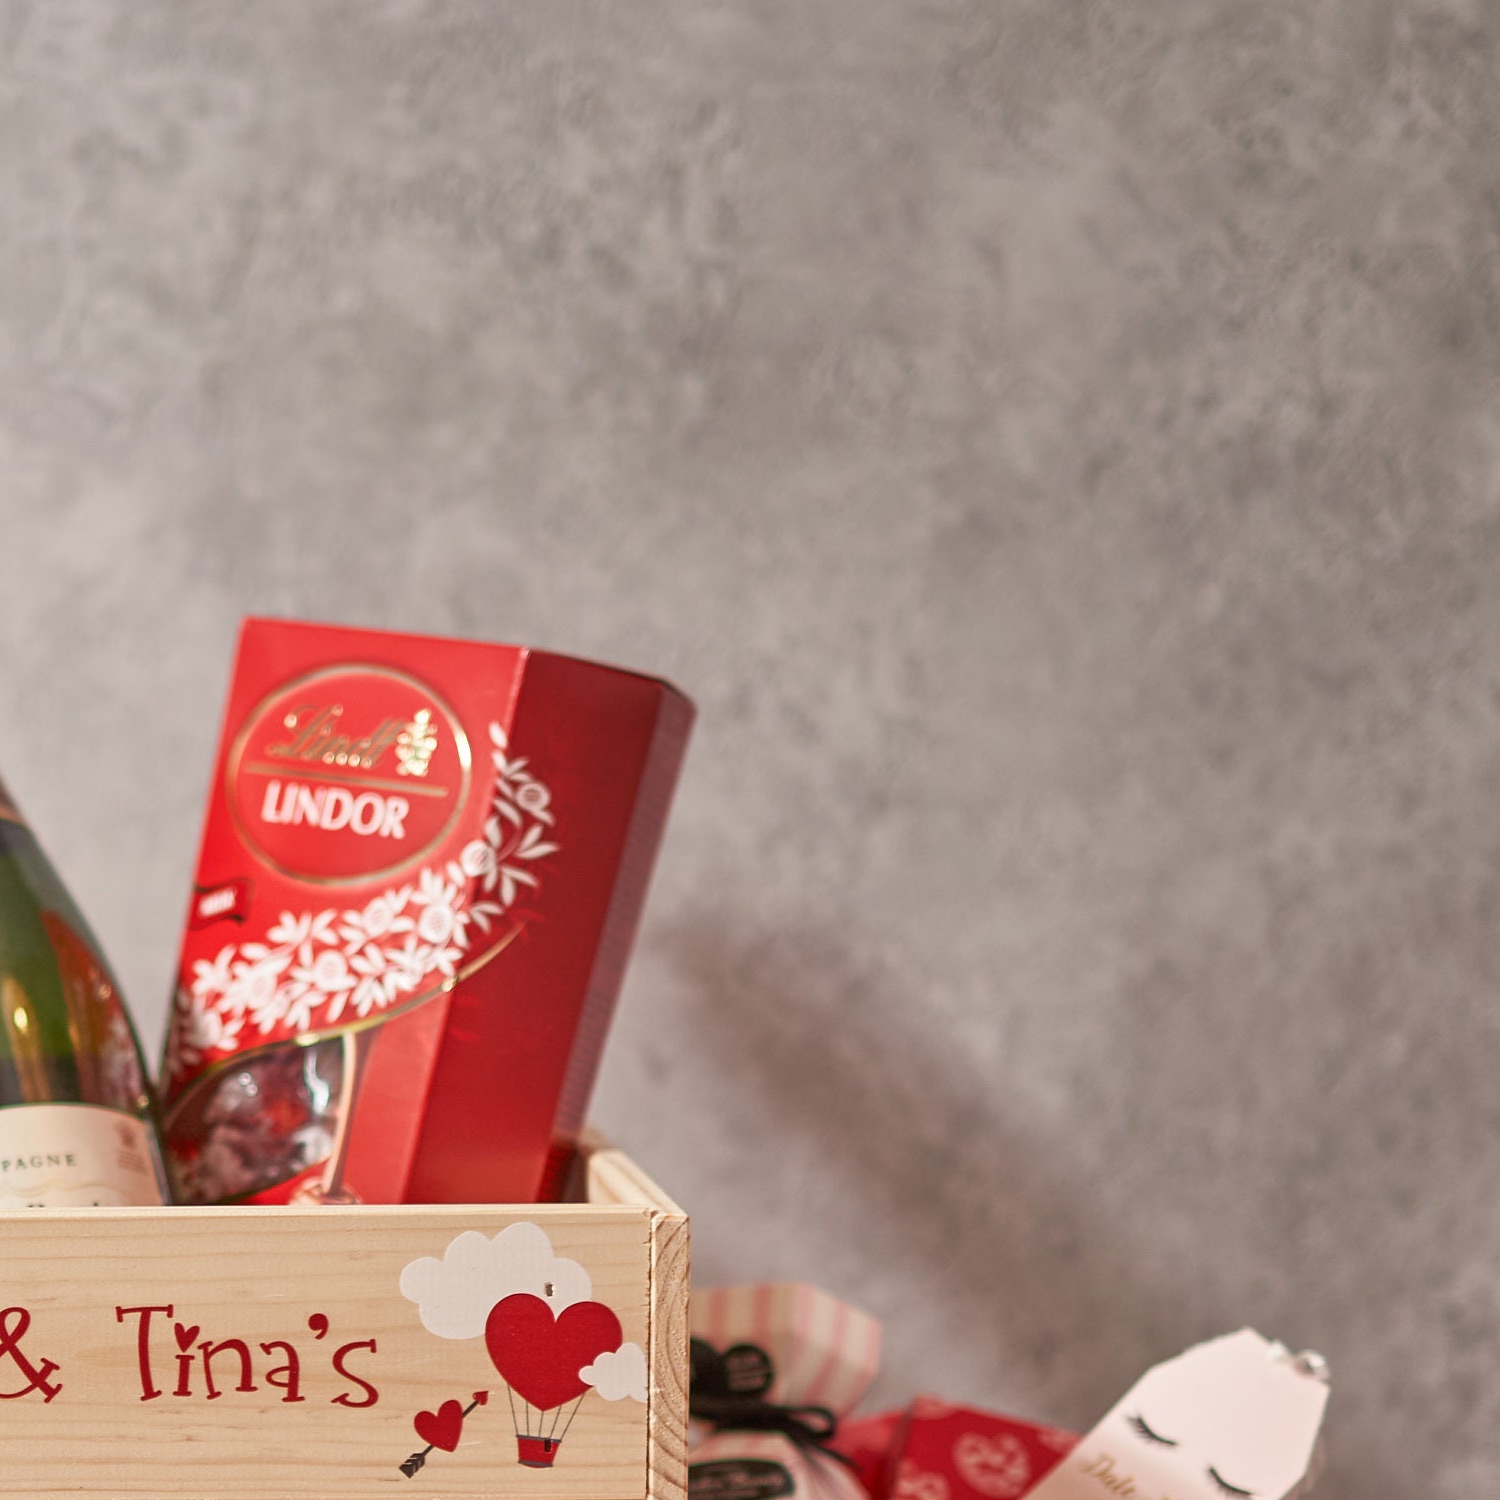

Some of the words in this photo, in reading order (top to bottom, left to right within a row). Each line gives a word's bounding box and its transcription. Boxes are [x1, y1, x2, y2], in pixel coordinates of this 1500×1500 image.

[266, 704, 410, 769] Lindt
[260, 779, 411, 841] LINDOR
[116, 1304, 379, 1408] Tina's
